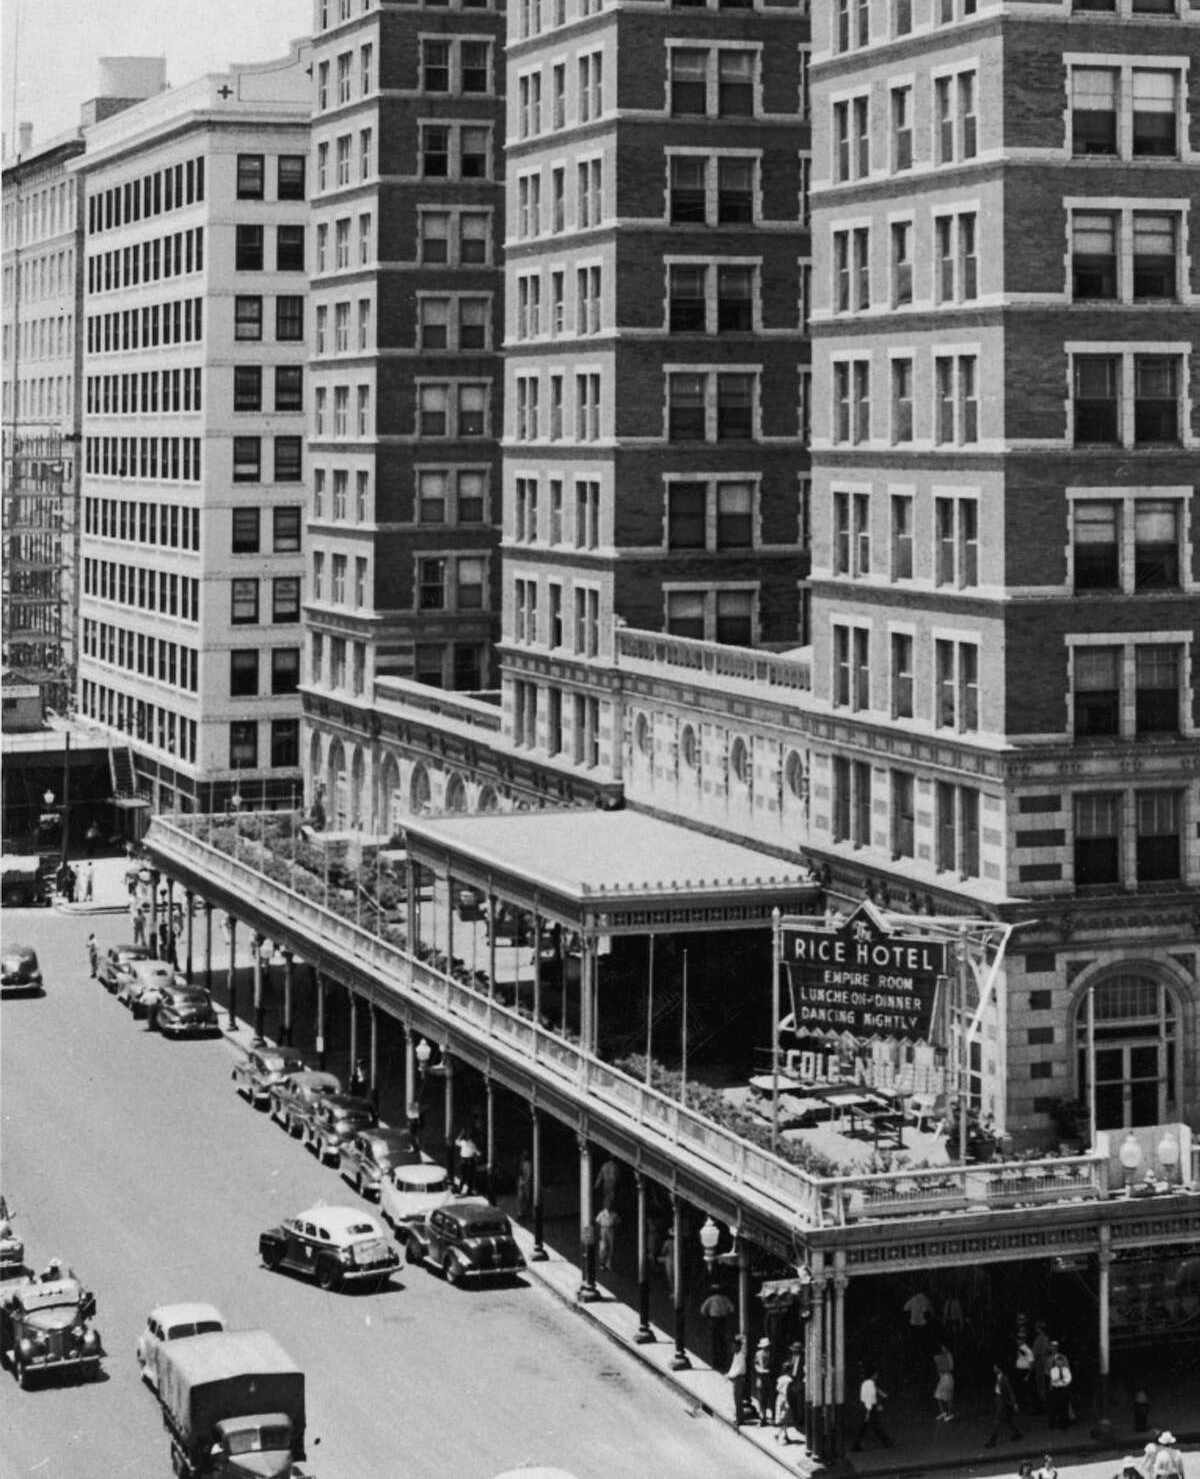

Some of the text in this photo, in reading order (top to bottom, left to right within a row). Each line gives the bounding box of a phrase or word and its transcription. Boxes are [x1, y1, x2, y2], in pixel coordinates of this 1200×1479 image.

[795, 938, 933, 971] RICE HOTEL
[824, 970, 913, 990] EMPIRE ROOM
[801, 1006, 918, 1030] DANCING NIGHTLY
